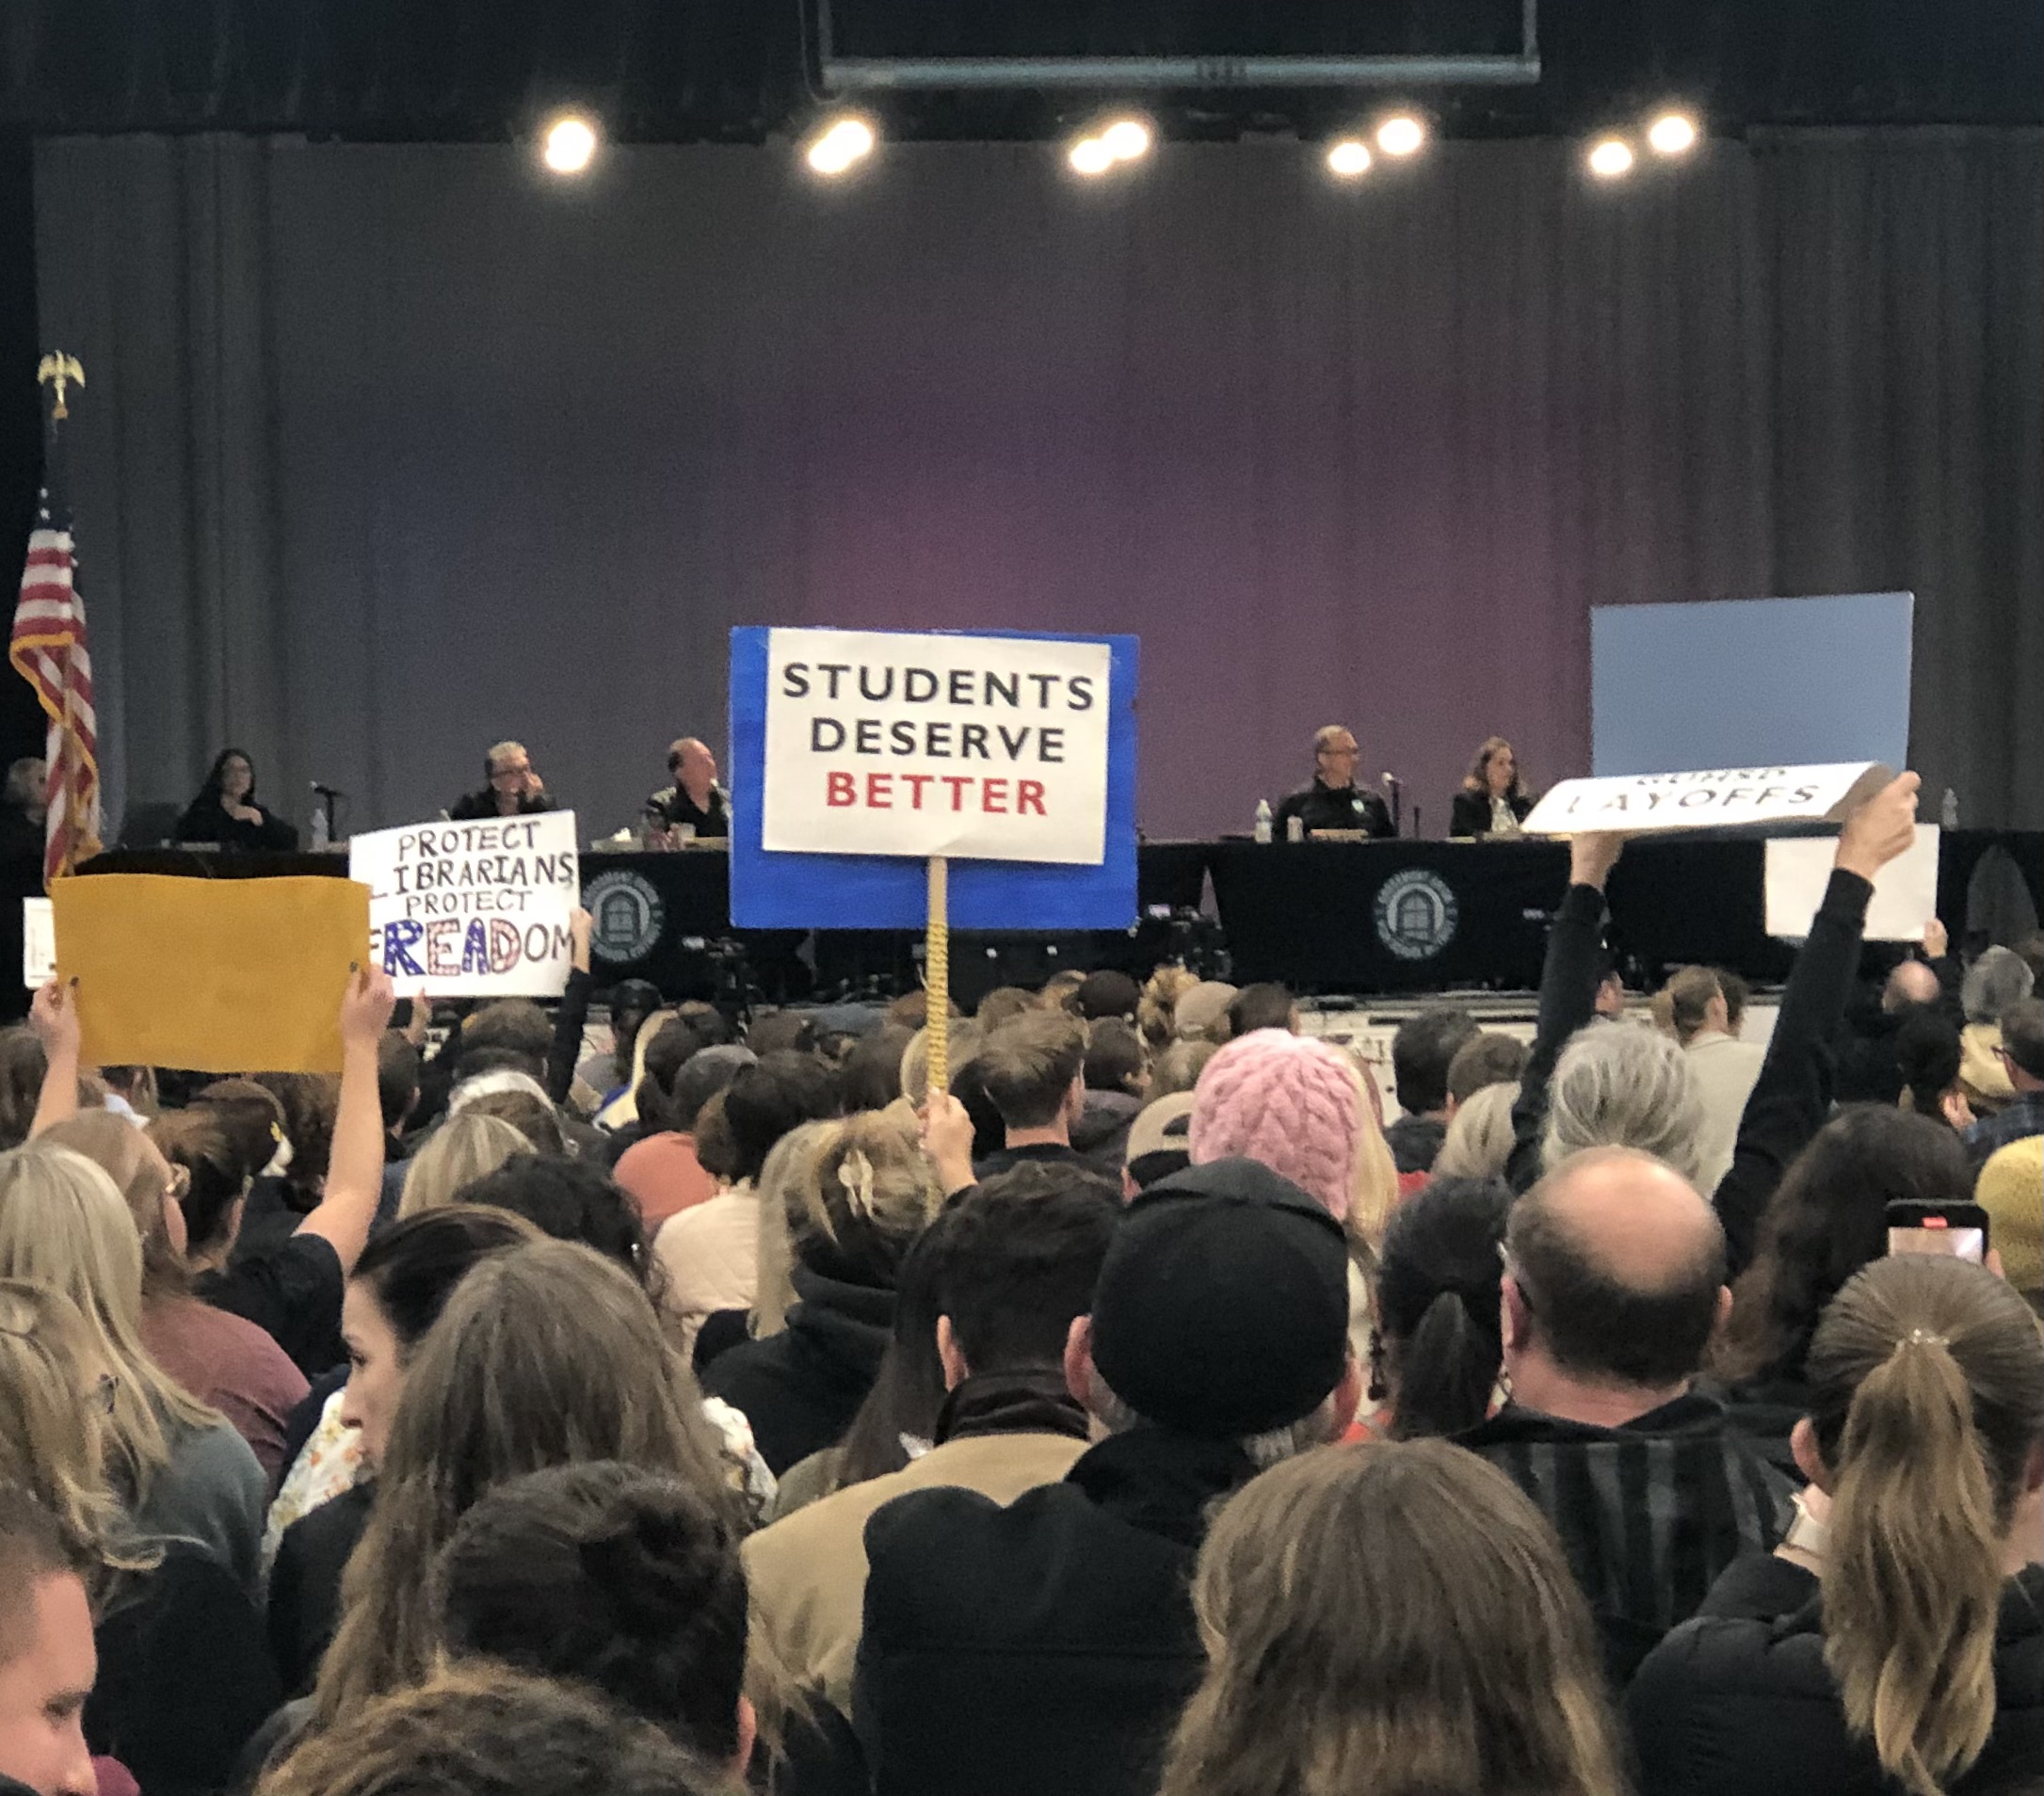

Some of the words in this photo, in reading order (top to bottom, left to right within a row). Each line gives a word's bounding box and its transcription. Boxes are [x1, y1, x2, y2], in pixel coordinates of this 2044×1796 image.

[783, 662, 1094, 711] STUDENTS
[811, 716, 1065, 762] DESERVE
[826, 771, 1048, 817] BETTER
[398, 821, 541, 861] PROTECT
[371, 852, 574, 899] IBRARIANS
[406, 890, 532, 917] PROTECT
